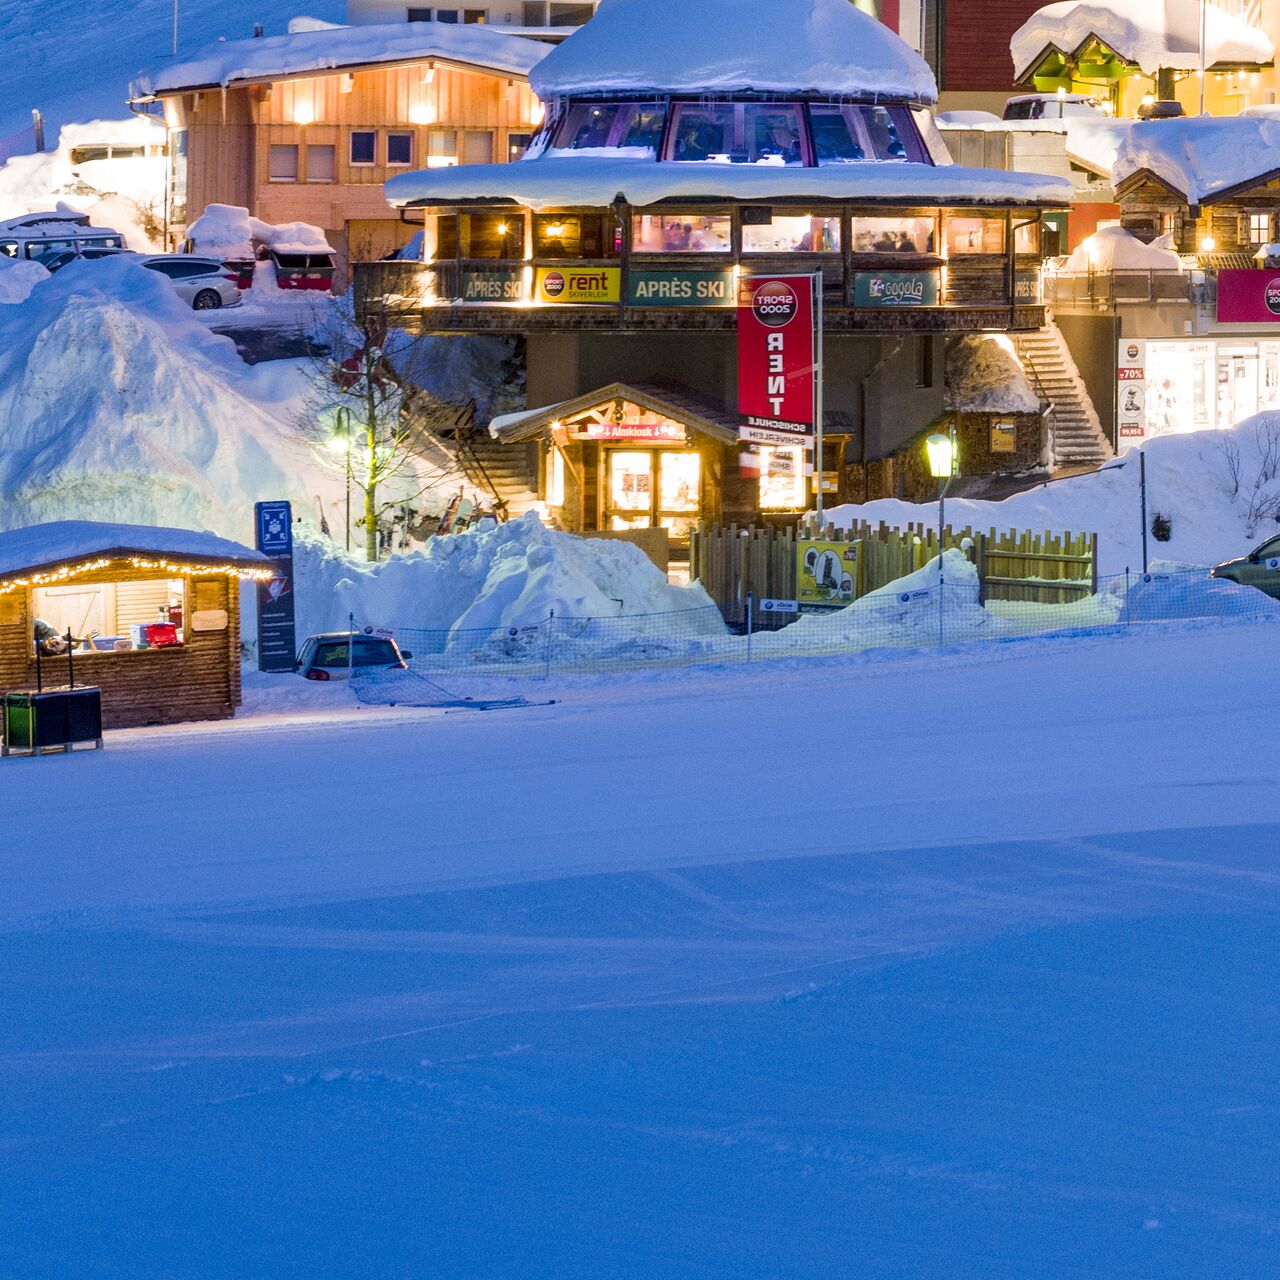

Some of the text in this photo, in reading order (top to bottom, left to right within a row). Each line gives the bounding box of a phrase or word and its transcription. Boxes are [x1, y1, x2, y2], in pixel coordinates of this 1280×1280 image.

[466, 278, 522, 297] APRÈS SKI
[569, 272, 608, 290] rent
[635, 277, 725, 298] APRÈS SKI
[611, 426, 653, 437] Almkiosk
